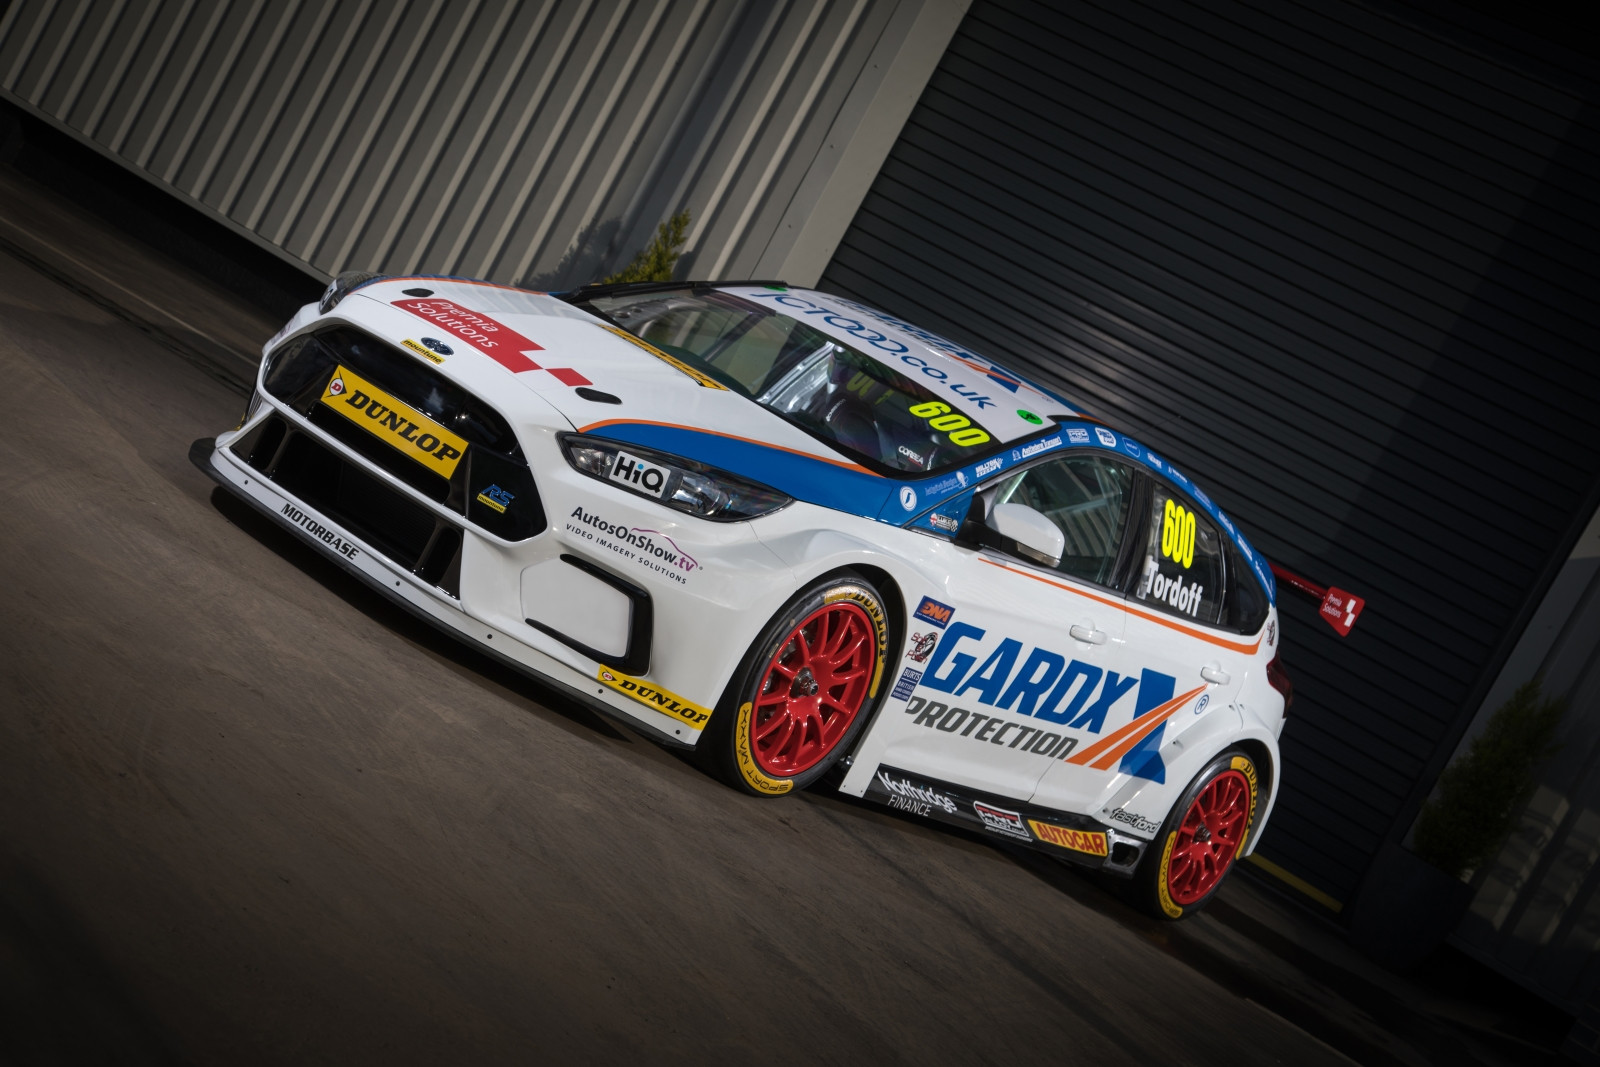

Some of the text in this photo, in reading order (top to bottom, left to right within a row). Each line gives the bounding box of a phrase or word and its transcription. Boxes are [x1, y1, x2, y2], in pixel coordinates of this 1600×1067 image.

[406, 302, 499, 348] Solutions
[431, 301, 499, 332] Premia
[402, 339, 443, 362] mountune
[345, 389, 461, 461] DUNLOP
[909, 401, 991, 447] 600
[481, 484, 515, 507] RS
[613, 456, 664, 493] HiQ
[281, 503, 359, 560] MOTORBASE
[566, 523, 687, 584] VIDEO IMAGERY SOLUTIONS
[571, 506, 695, 572] AutosOnShow.tv
[1162, 499, 1196, 569] 600
[1147, 560, 1204, 617] Tordoff
[852, 593, 888, 663] DUNLOP
[921, 601, 951, 623] DNA
[903, 667, 921, 681] BURTS
[920, 621, 1139, 734] GARDX
[618, 680, 709, 723] DUNLOP
[739, 709, 789, 792] SPORT MAXX
[905, 696, 1079, 760] PROTECTION
[887, 794, 932, 817] FINANCE
[1035, 822, 1106, 855] AUTOCAR
